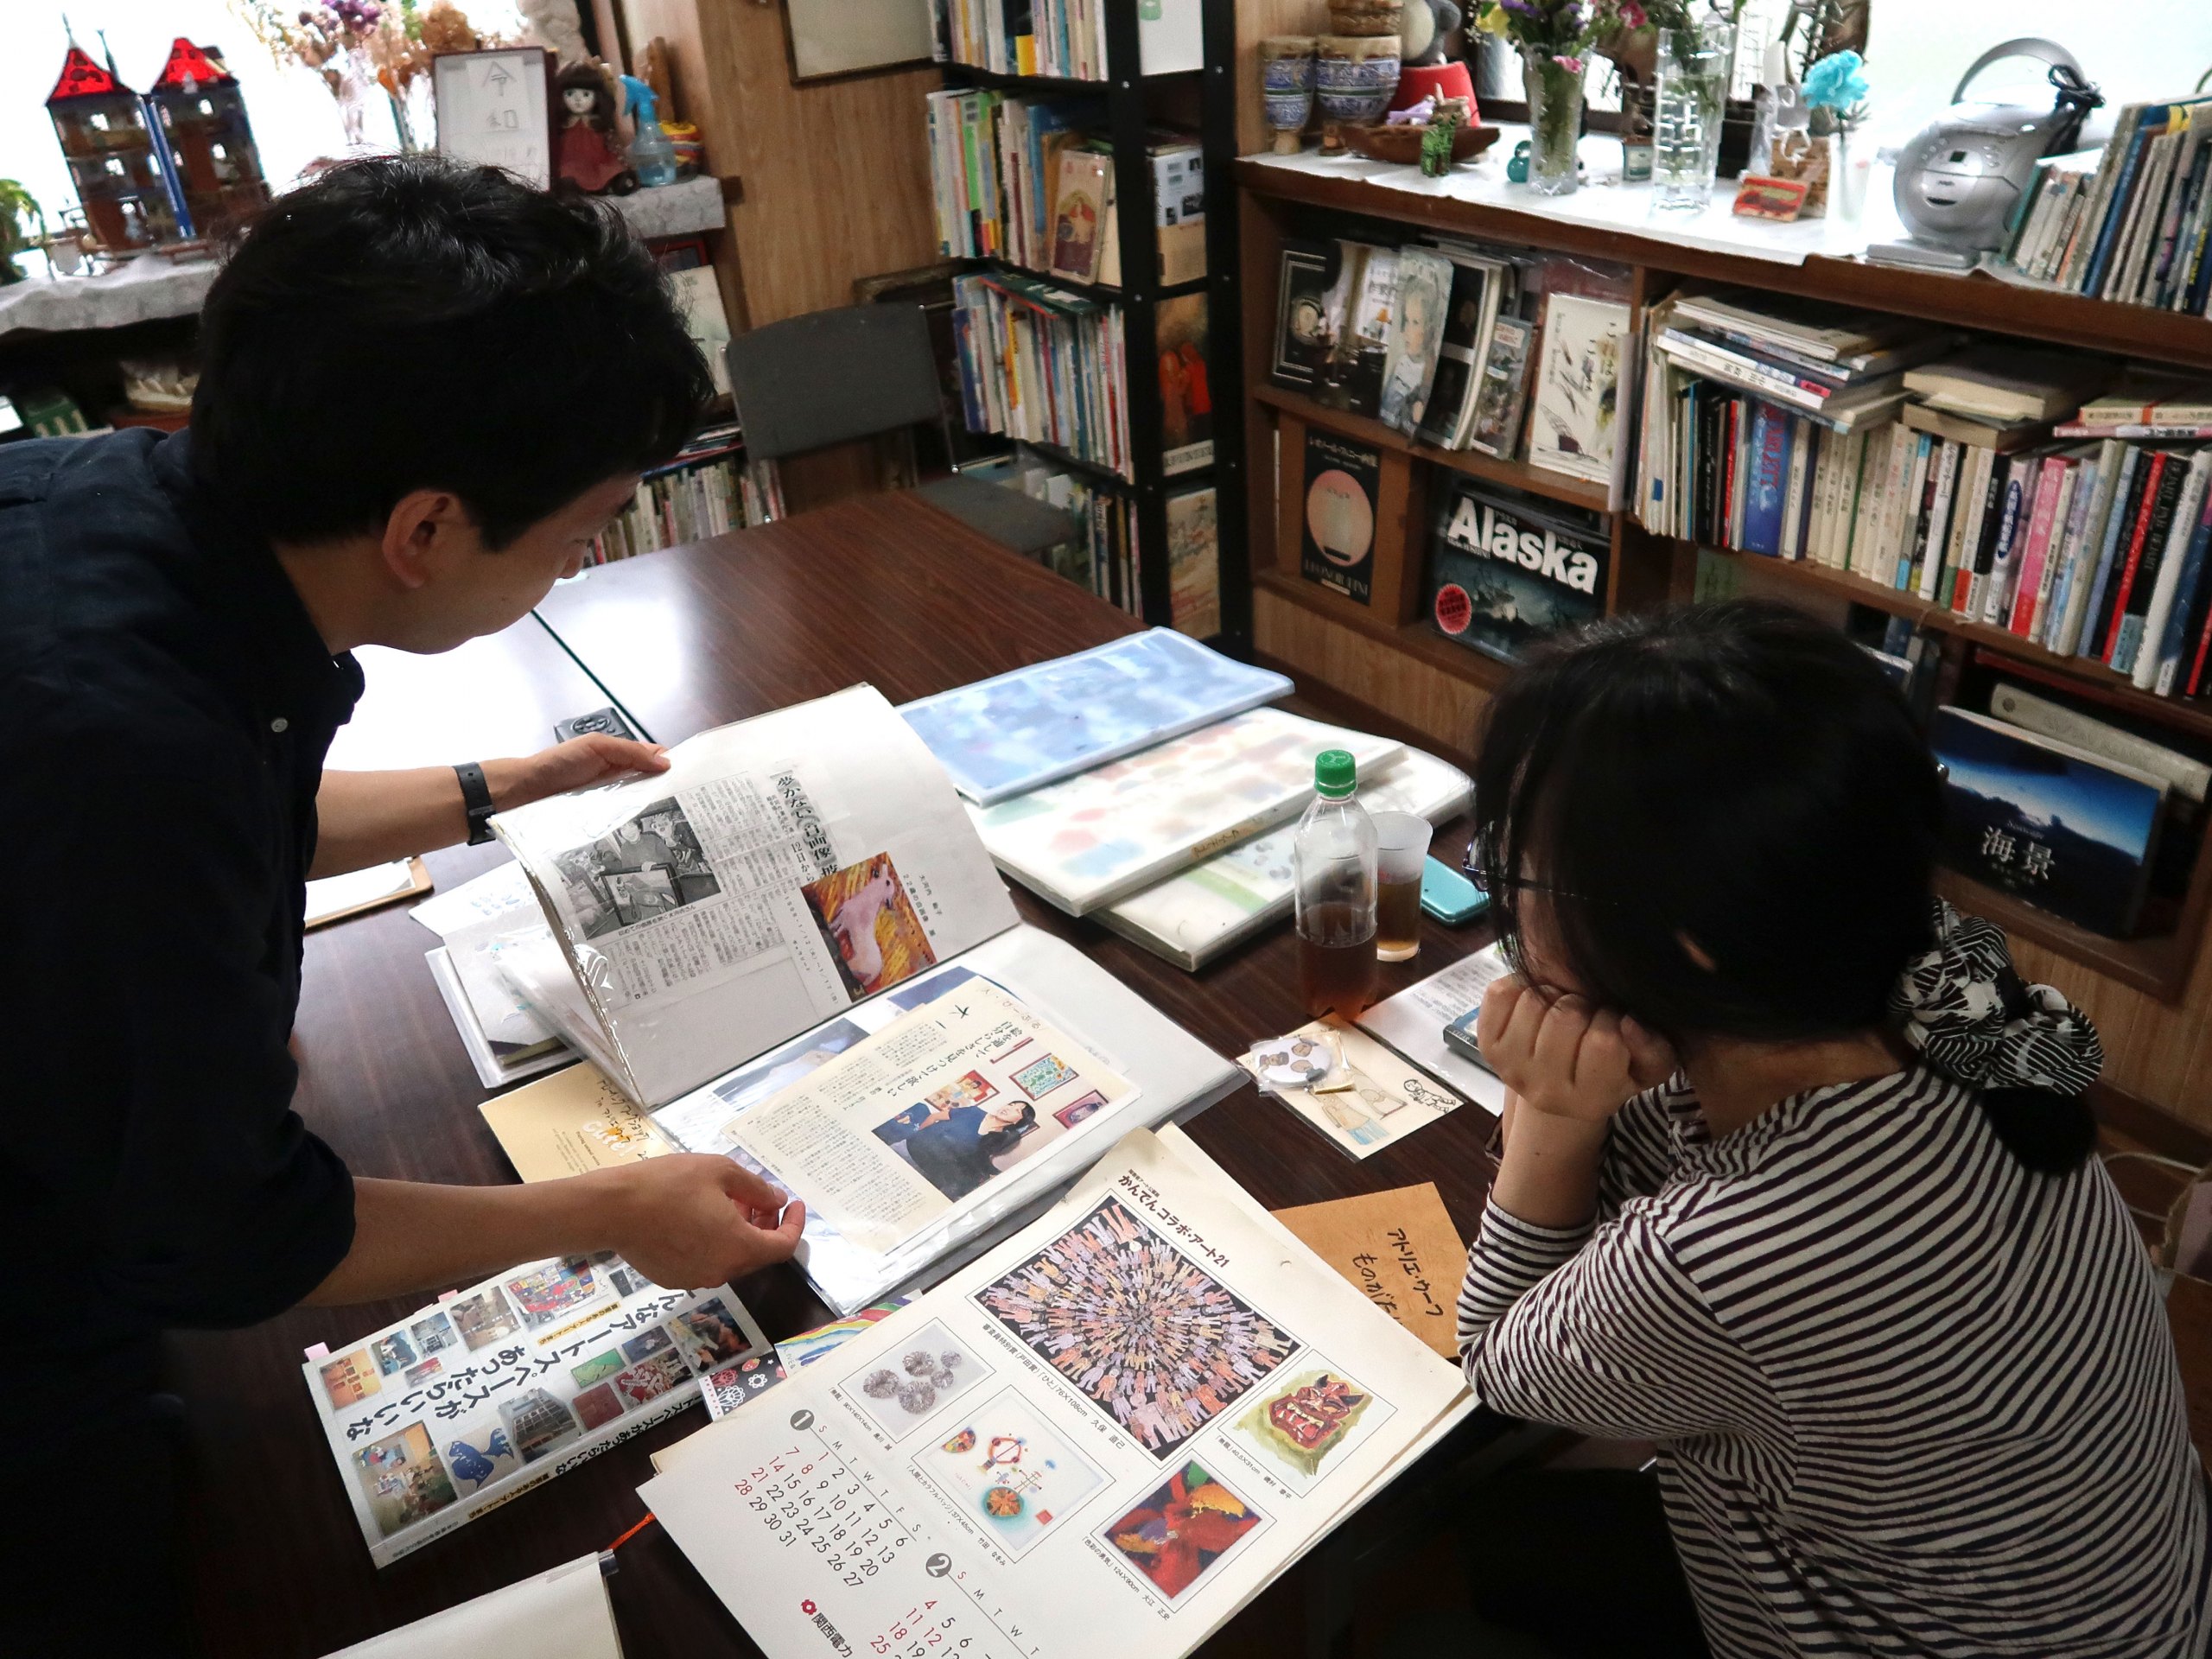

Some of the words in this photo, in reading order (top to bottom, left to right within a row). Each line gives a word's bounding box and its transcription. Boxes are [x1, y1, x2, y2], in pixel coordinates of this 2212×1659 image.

[1447, 496, 1599, 595] Alaska
[790, 841, 816, 881] 12日から
[1981, 825, 2056, 880] 海景
[886, 1020, 1012, 1097] 自分らしさを見つけて欲しい
[976, 1020, 1023, 1058] 絵を通して
[1387, 1227, 1444, 1316] アトリエ・ウーフ
[346, 1344, 525, 1442] あったらいいな
[1090, 1419, 1108, 1433] 久保
[734, 1478, 753, 1496] 28
[748, 1496, 768, 1512] 29
[764, 1513, 783, 1531] 30
[779, 1530, 798, 1548] 31
[768, 1456, 786, 1472] 14
[784, 1472, 802, 1490] 15
[798, 1490, 816, 1506] 16
[813, 1506, 832, 1520] 17
[829, 1523, 847, 1541] 18
[845, 1541, 863, 1557] 19
[859, 1559, 880, 1577] 20
[785, 1446, 800, 1455] 7
[801, 1464, 814, 1475] 8
[816, 1480, 829, 1490] 9
[830, 1494, 847, 1510] 10
[845, 1510, 861, 1528] 11
[861, 1528, 879, 1547] 12
[877, 1545, 895, 1564] 13
[818, 1452, 830, 1461] 1
[832, 1467, 845, 1479] 2
[847, 1484, 861, 1495] 3
[863, 1503, 876, 1512] 4
[879, 1518, 893, 1529] 5
[895, 1537, 909, 1548] 6
[832, 1440, 843, 1451] M
[863, 1471, 875, 1482] W
[880, 1489, 889, 1497] T
[912, 1523, 922, 1533] S
[751, 1466, 769, 1483] 21
[766, 1484, 785, 1502] 22
[780, 1501, 800, 1519] 23
[795, 1518, 815, 1536] 24
[810, 1535, 831, 1554] 25
[826, 1554, 847, 1572] 26
[842, 1571, 865, 1586] 27
[977, 1536, 991, 1550] 竹田
[906, 1607, 924, 1625] 11
[923, 1626, 943, 1647] 12
[925, 1599, 938, 1610] 4
[941, 1617, 956, 1629] 5
[959, 1637, 973, 1649] 6
[957, 1571, 967, 1580] S
[973, 1588, 986, 1600] M
[994, 1607, 1003, 1618] T
[1010, 1624, 1023, 1638] W
[1029, 1646, 1040, 1656] T
[1141, 1593, 1156, 1607] 大江
[811, 1611, 854, 1659] 関西電力
[870, 1635, 892, 1655] 25
[888, 1621, 908, 1640] 18
[906, 1640, 925, 1658] 19
